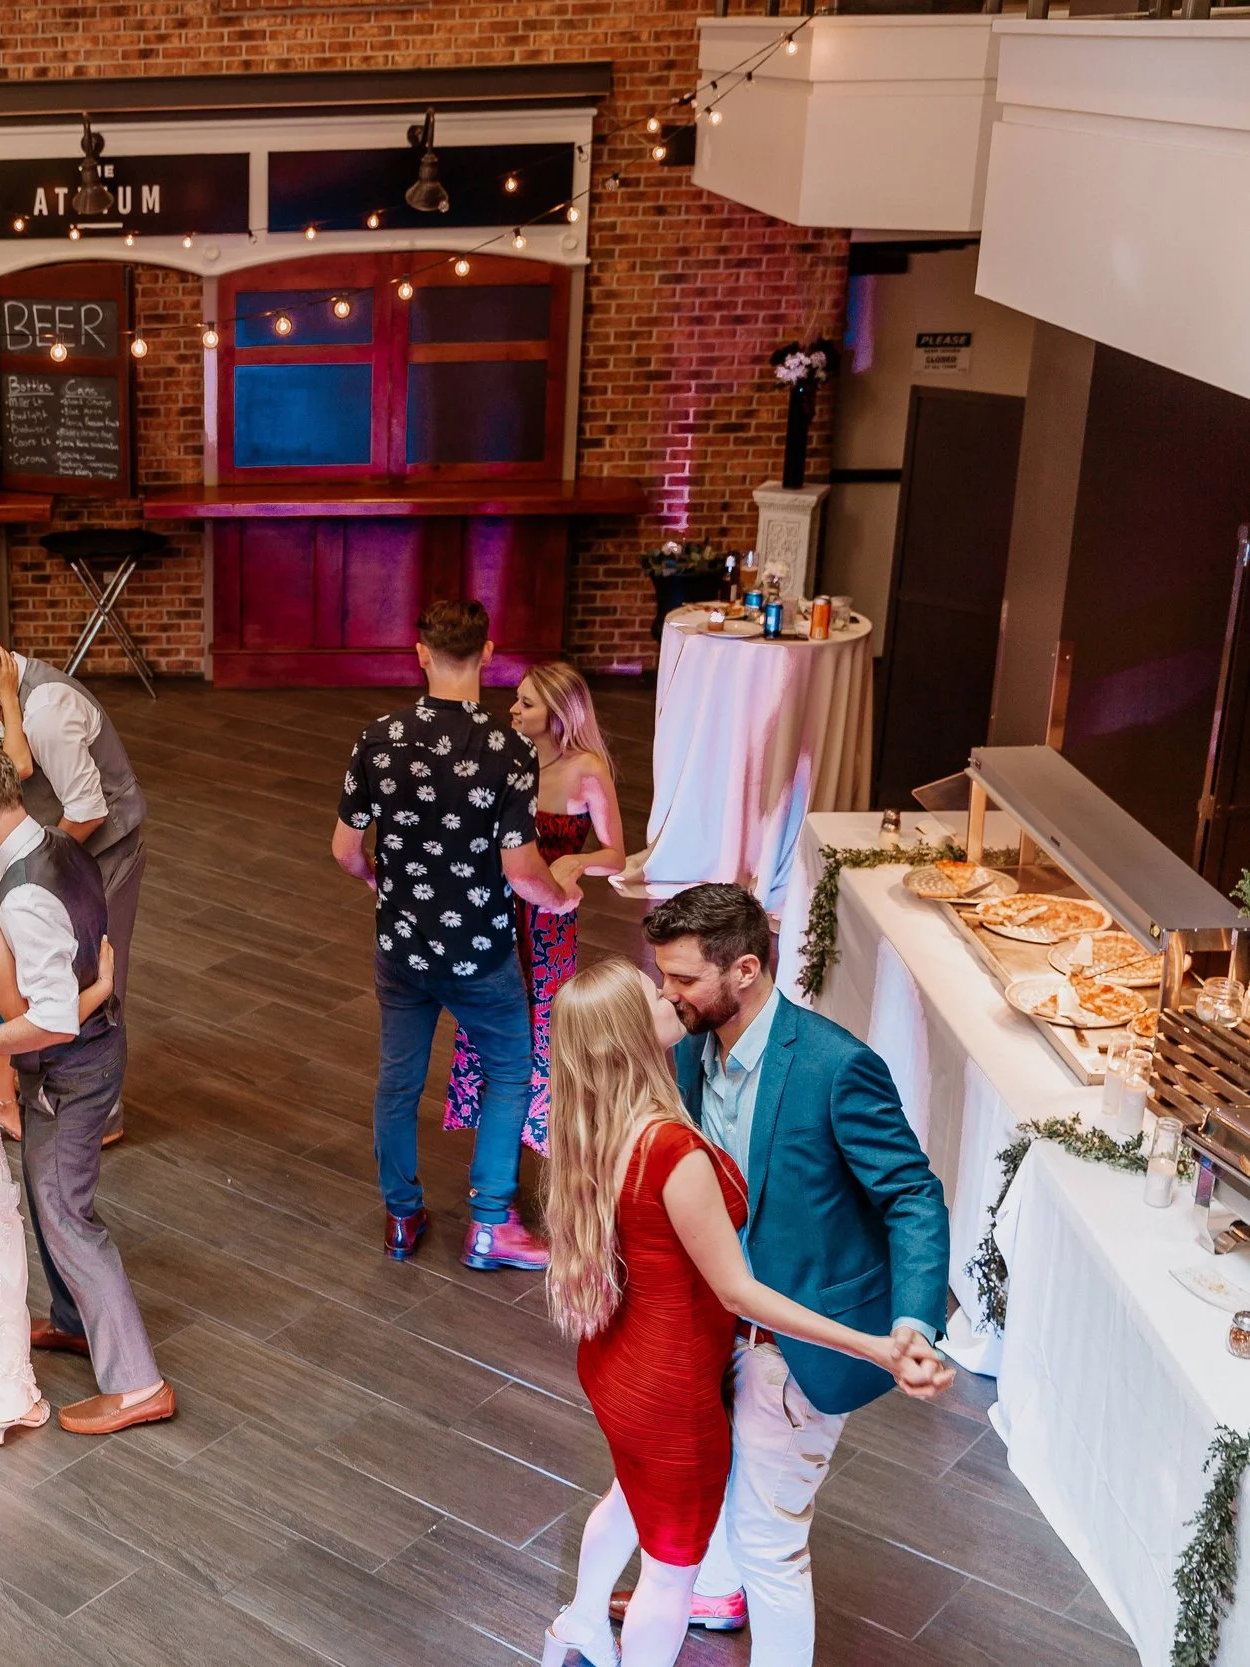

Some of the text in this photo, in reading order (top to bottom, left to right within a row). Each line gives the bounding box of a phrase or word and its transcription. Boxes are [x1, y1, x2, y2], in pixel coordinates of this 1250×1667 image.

[33, 185, 160, 216] ATUM
[4, 300, 106, 351] BEER
[920, 335, 967, 345] PLEASE
[8, 376, 52, 394] Bottles
[63, 379, 99, 396] Cans
[8, 397, 30, 408] Miller
[13, 436, 36, 447] Coors
[13, 452, 48, 465] Corona
